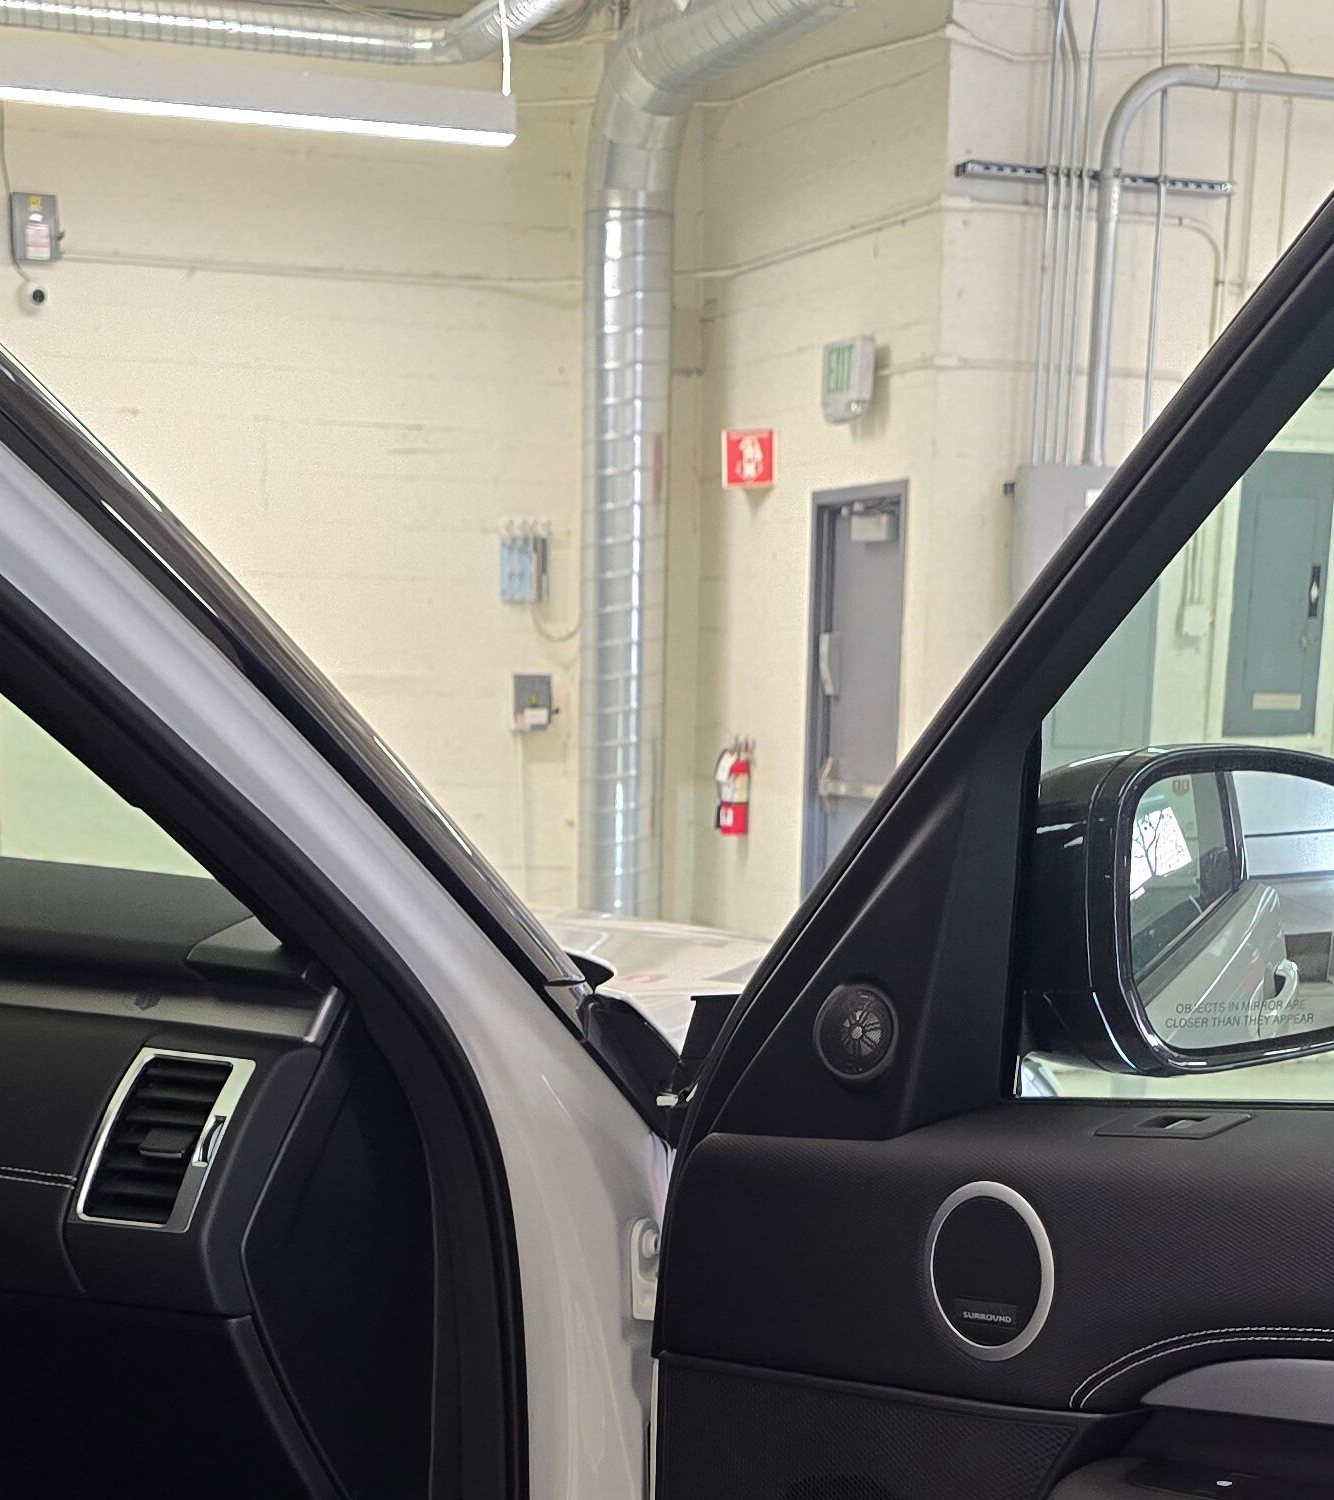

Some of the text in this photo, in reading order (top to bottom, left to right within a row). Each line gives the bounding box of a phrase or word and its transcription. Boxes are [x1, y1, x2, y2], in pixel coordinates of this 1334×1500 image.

[827, 344, 854, 394] EXIT
[1175, 999, 1307, 1014] OBJECTS IN MIRROR ARE
[1165, 1012, 1315, 1029] CLOSER THAN THEY APPEAR
[962, 1311, 1012, 1323] SURROUND
